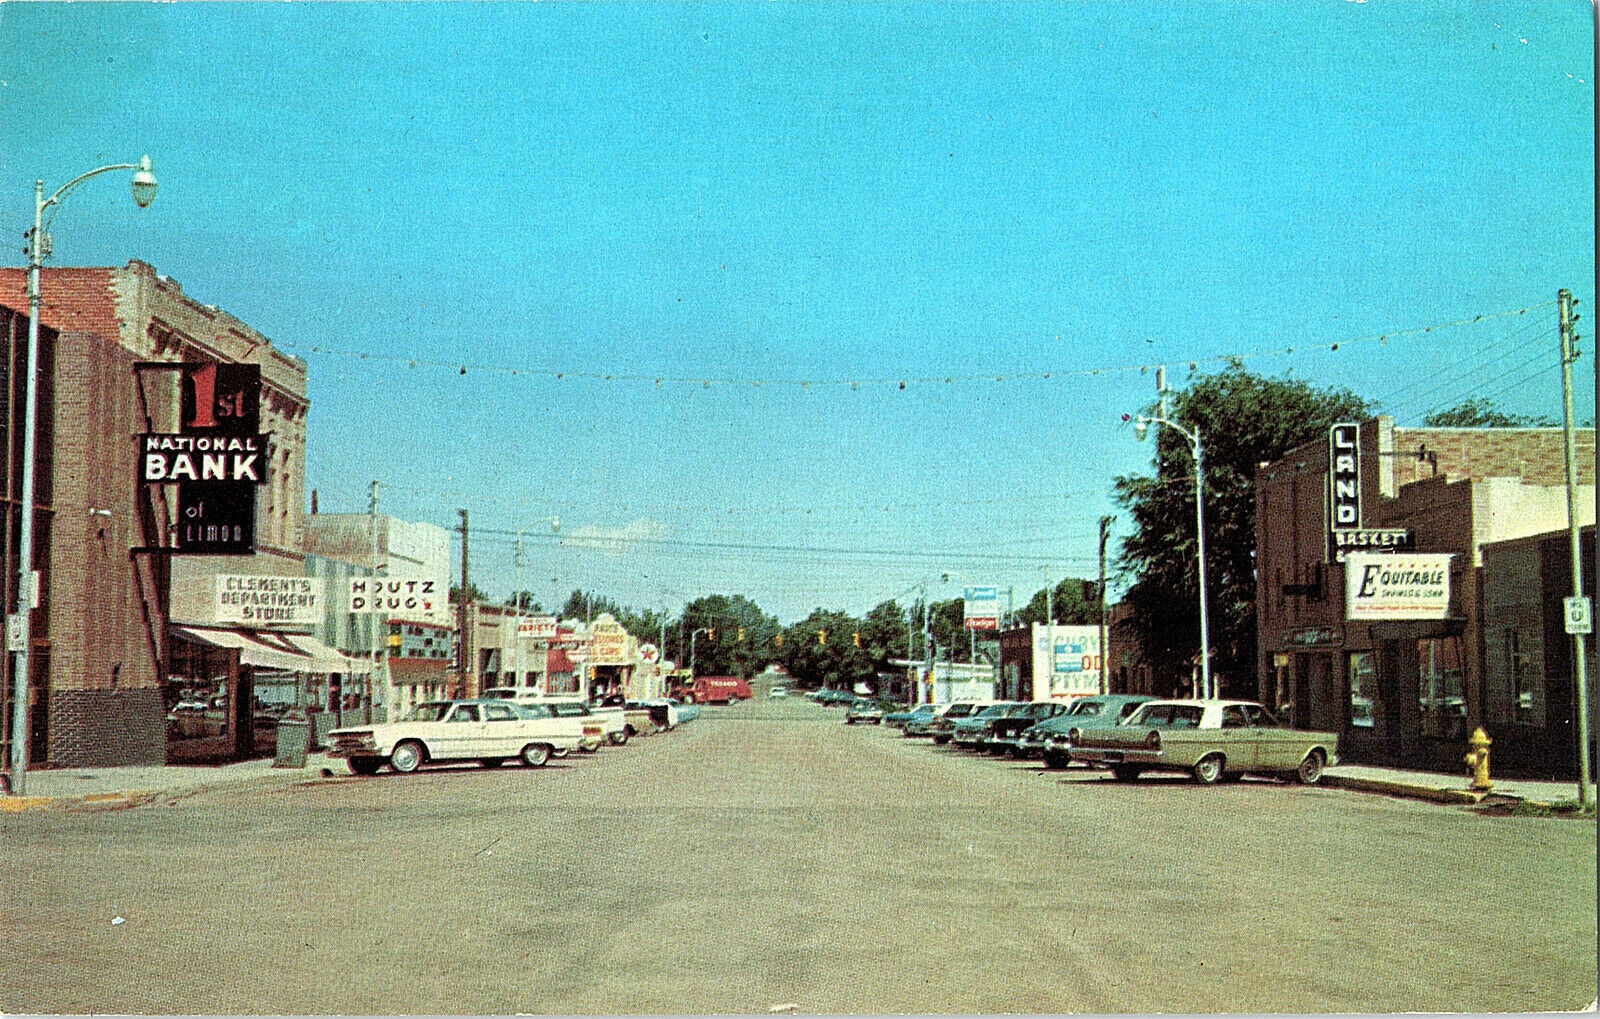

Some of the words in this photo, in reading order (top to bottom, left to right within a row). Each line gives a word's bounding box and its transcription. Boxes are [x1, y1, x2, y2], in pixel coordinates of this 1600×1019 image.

[146, 436, 258, 452] NATIONAL
[144, 452, 258, 480] BANK
[1336, 430, 1356, 523] LAND
[186, 501, 204, 518] of
[1356, 564, 1444, 598] EQUITABLE
[221, 592, 315, 607] DEPARTMENT
[242, 606, 294, 620] STORE
[1571, 611, 1583, 622] U
